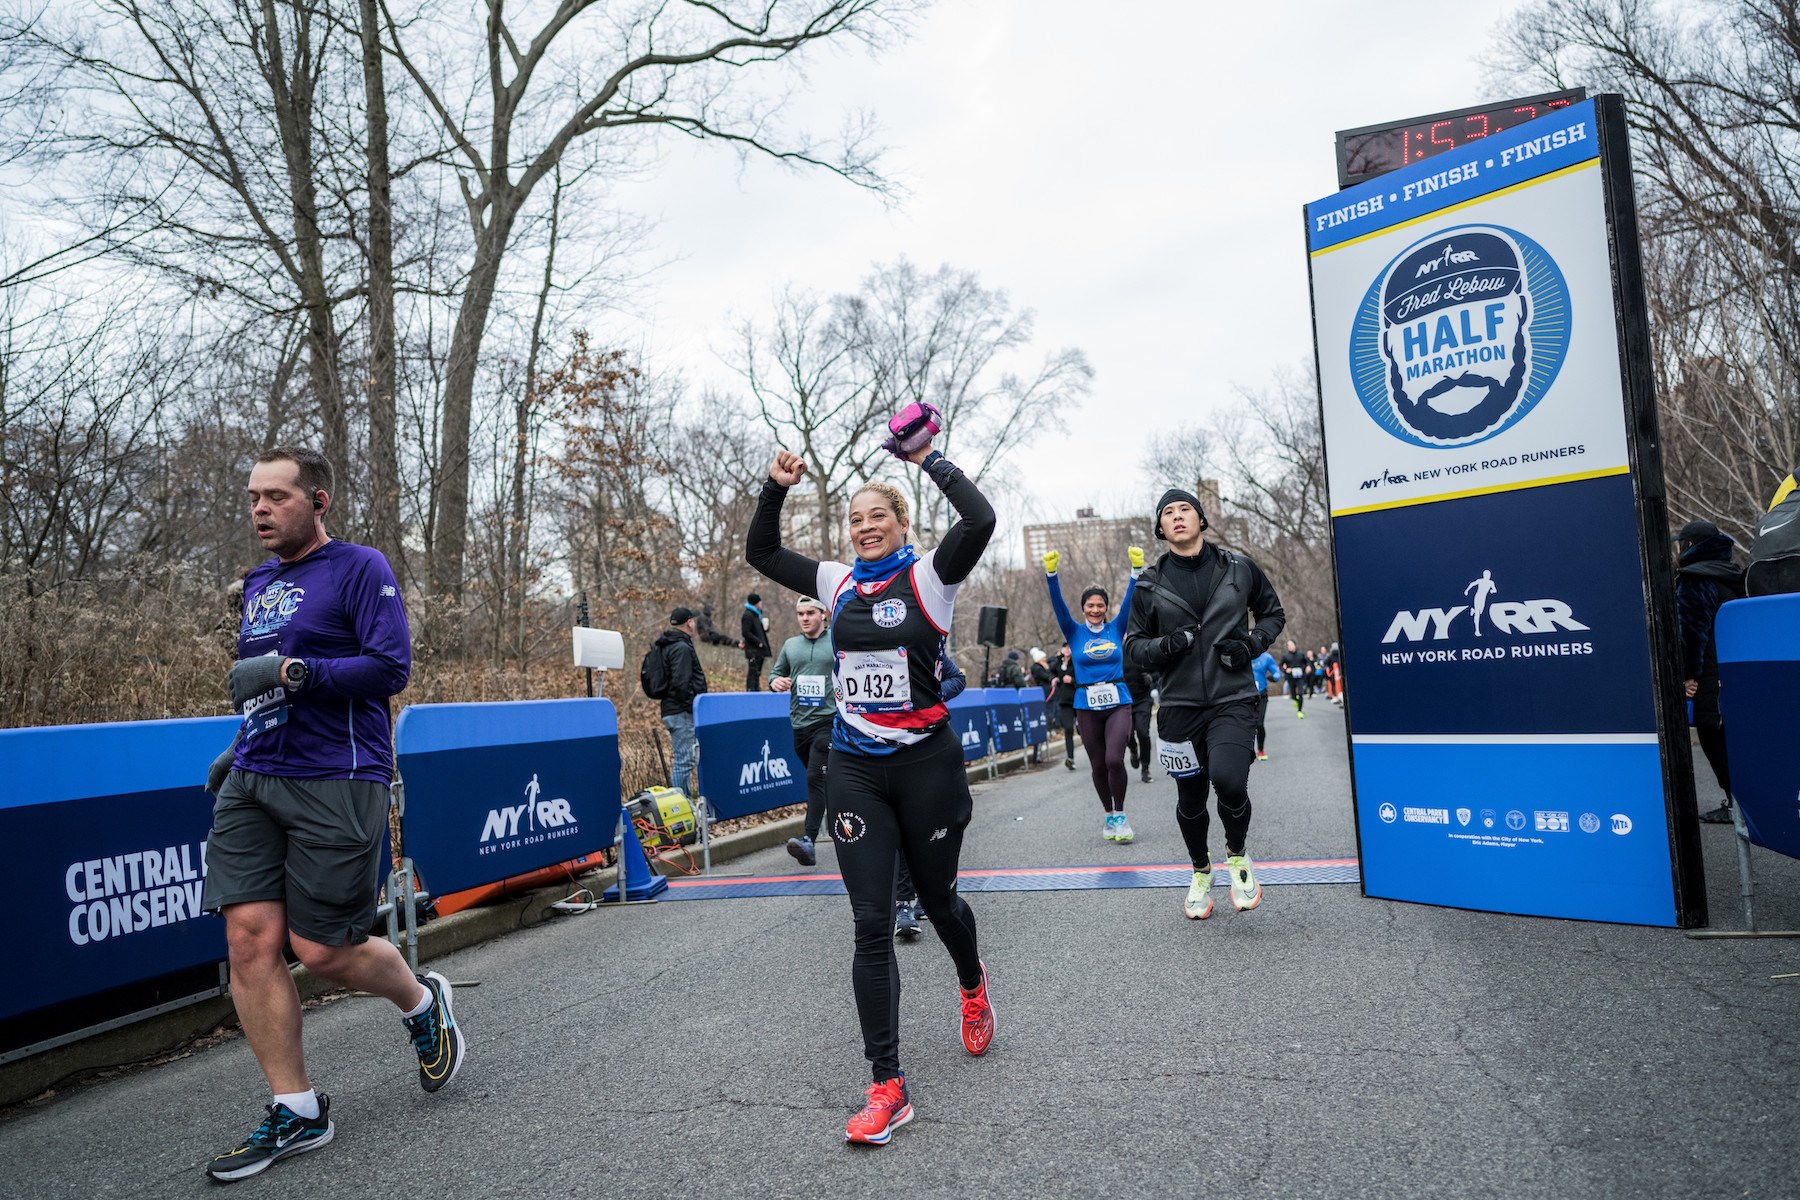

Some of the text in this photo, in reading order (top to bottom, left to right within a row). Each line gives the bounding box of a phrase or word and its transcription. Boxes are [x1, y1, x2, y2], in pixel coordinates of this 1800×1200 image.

[1316, 122, 1587, 232] FINISH FINISH FINISH
[1415, 248, 1480, 278] NYRR
[1397, 276, 1506, 319] Fred Lebow
[1402, 303, 1505, 362] HALF
[1406, 344, 1506, 382] MARATHON
[1414, 469, 1442, 481] NEW
[1445, 463, 1478, 476] YORK
[1481, 456, 1517, 470] ROAD
[1522, 444, 1586, 464] RUNNERS
[246, 587, 305, 623] NYC
[1381, 598, 1591, 644] NYRR
[1381, 642, 1594, 665] NEW YORK ROAD RUNNERS
[845, 674, 894, 699] D 432
[1090, 693, 1113, 705] D 683
[264, 717, 278, 729] 2390
[739, 757, 792, 787] NYRR
[763, 782, 775, 790] ROAD
[775, 779, 793, 787] RUNNERS
[480, 798, 577, 843] NYRR
[1403, 807, 1443, 817] CENTRAL PARK
[1403, 815, 1443, 824] CONSERVANCY
[1536, 818, 1568, 831] DOT
[1611, 818, 1629, 831] MTA
[480, 826, 579, 856] NEW YORK ROAD RUNNERS
[65, 844, 197, 903] CENTRAL
[69, 880, 210, 946] CONSERV
